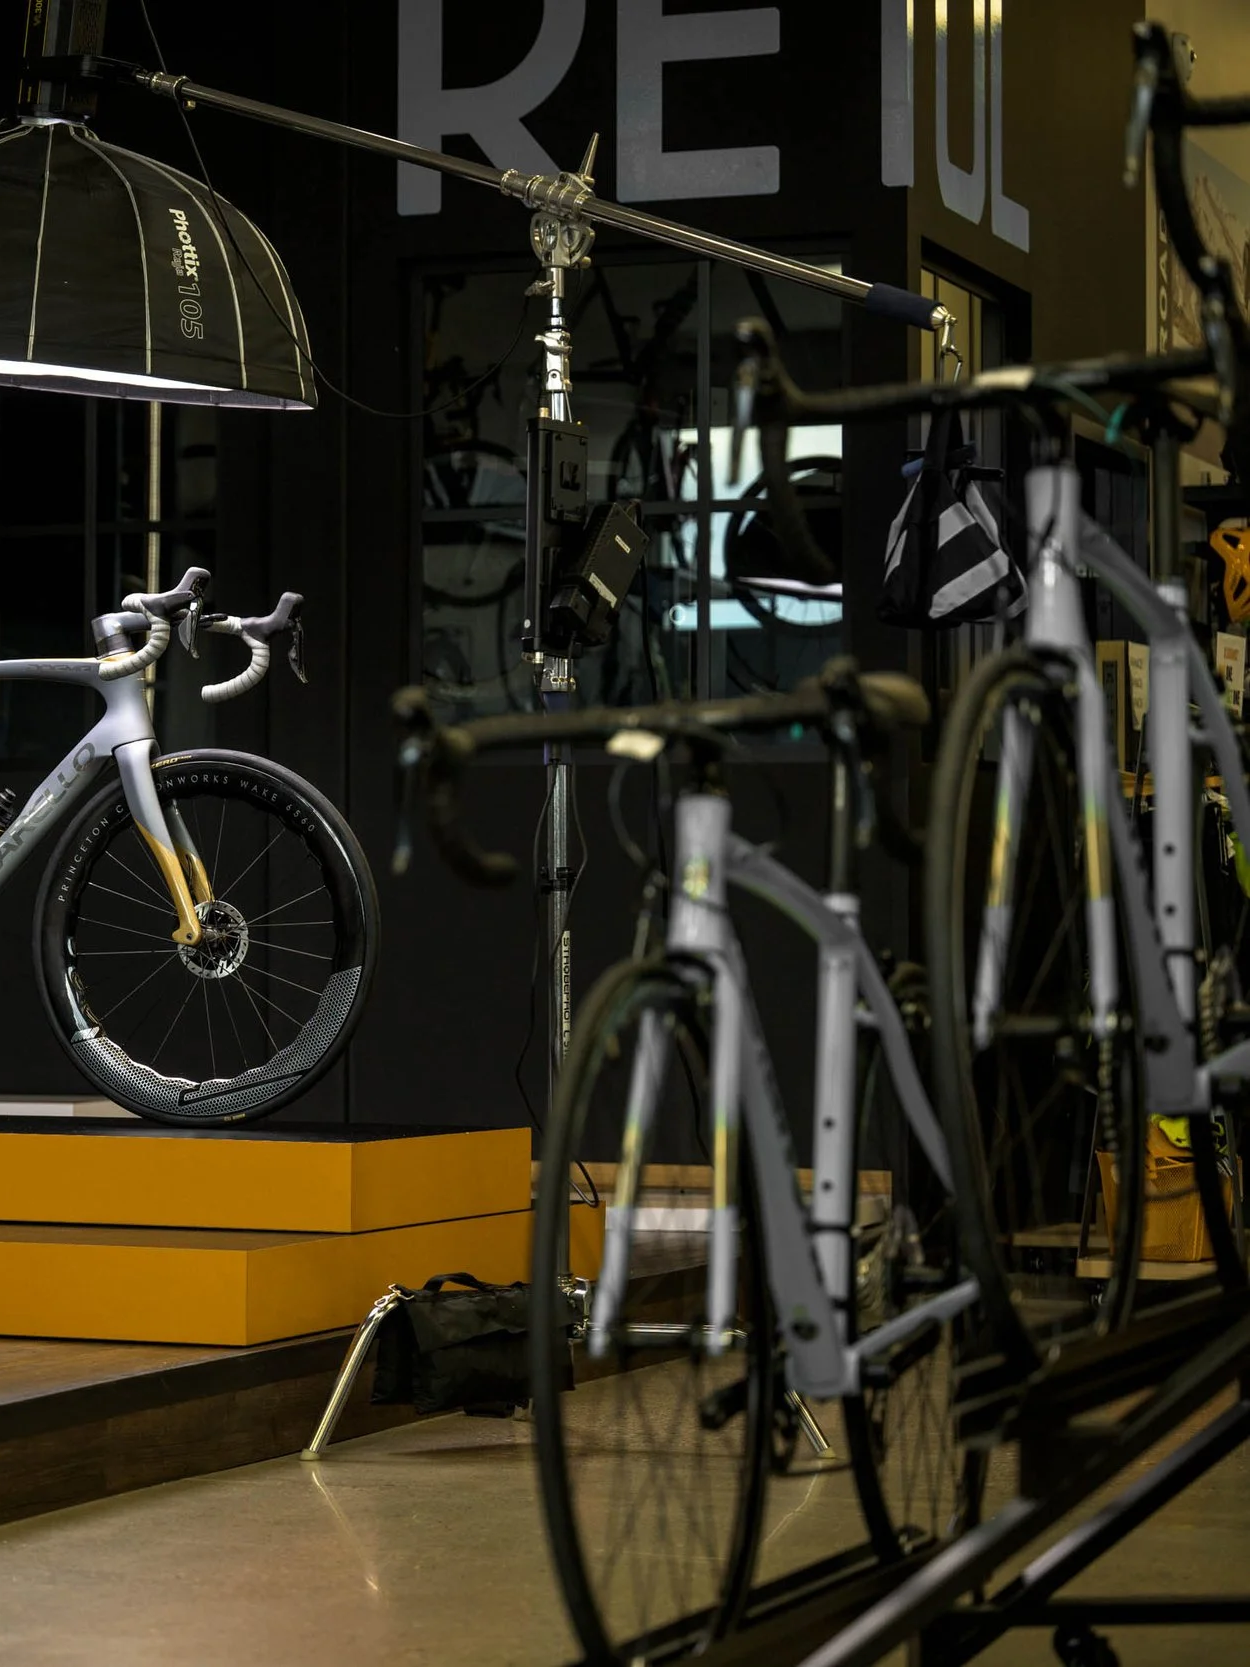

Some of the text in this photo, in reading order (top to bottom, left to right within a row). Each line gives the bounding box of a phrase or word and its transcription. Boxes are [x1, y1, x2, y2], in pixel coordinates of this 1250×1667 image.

[169, 208, 204, 340] Phottix 105
[57, 817, 110, 903] PRINCETON
[239, 779, 278, 803] WAKE
[284, 803, 315, 832] 6560
